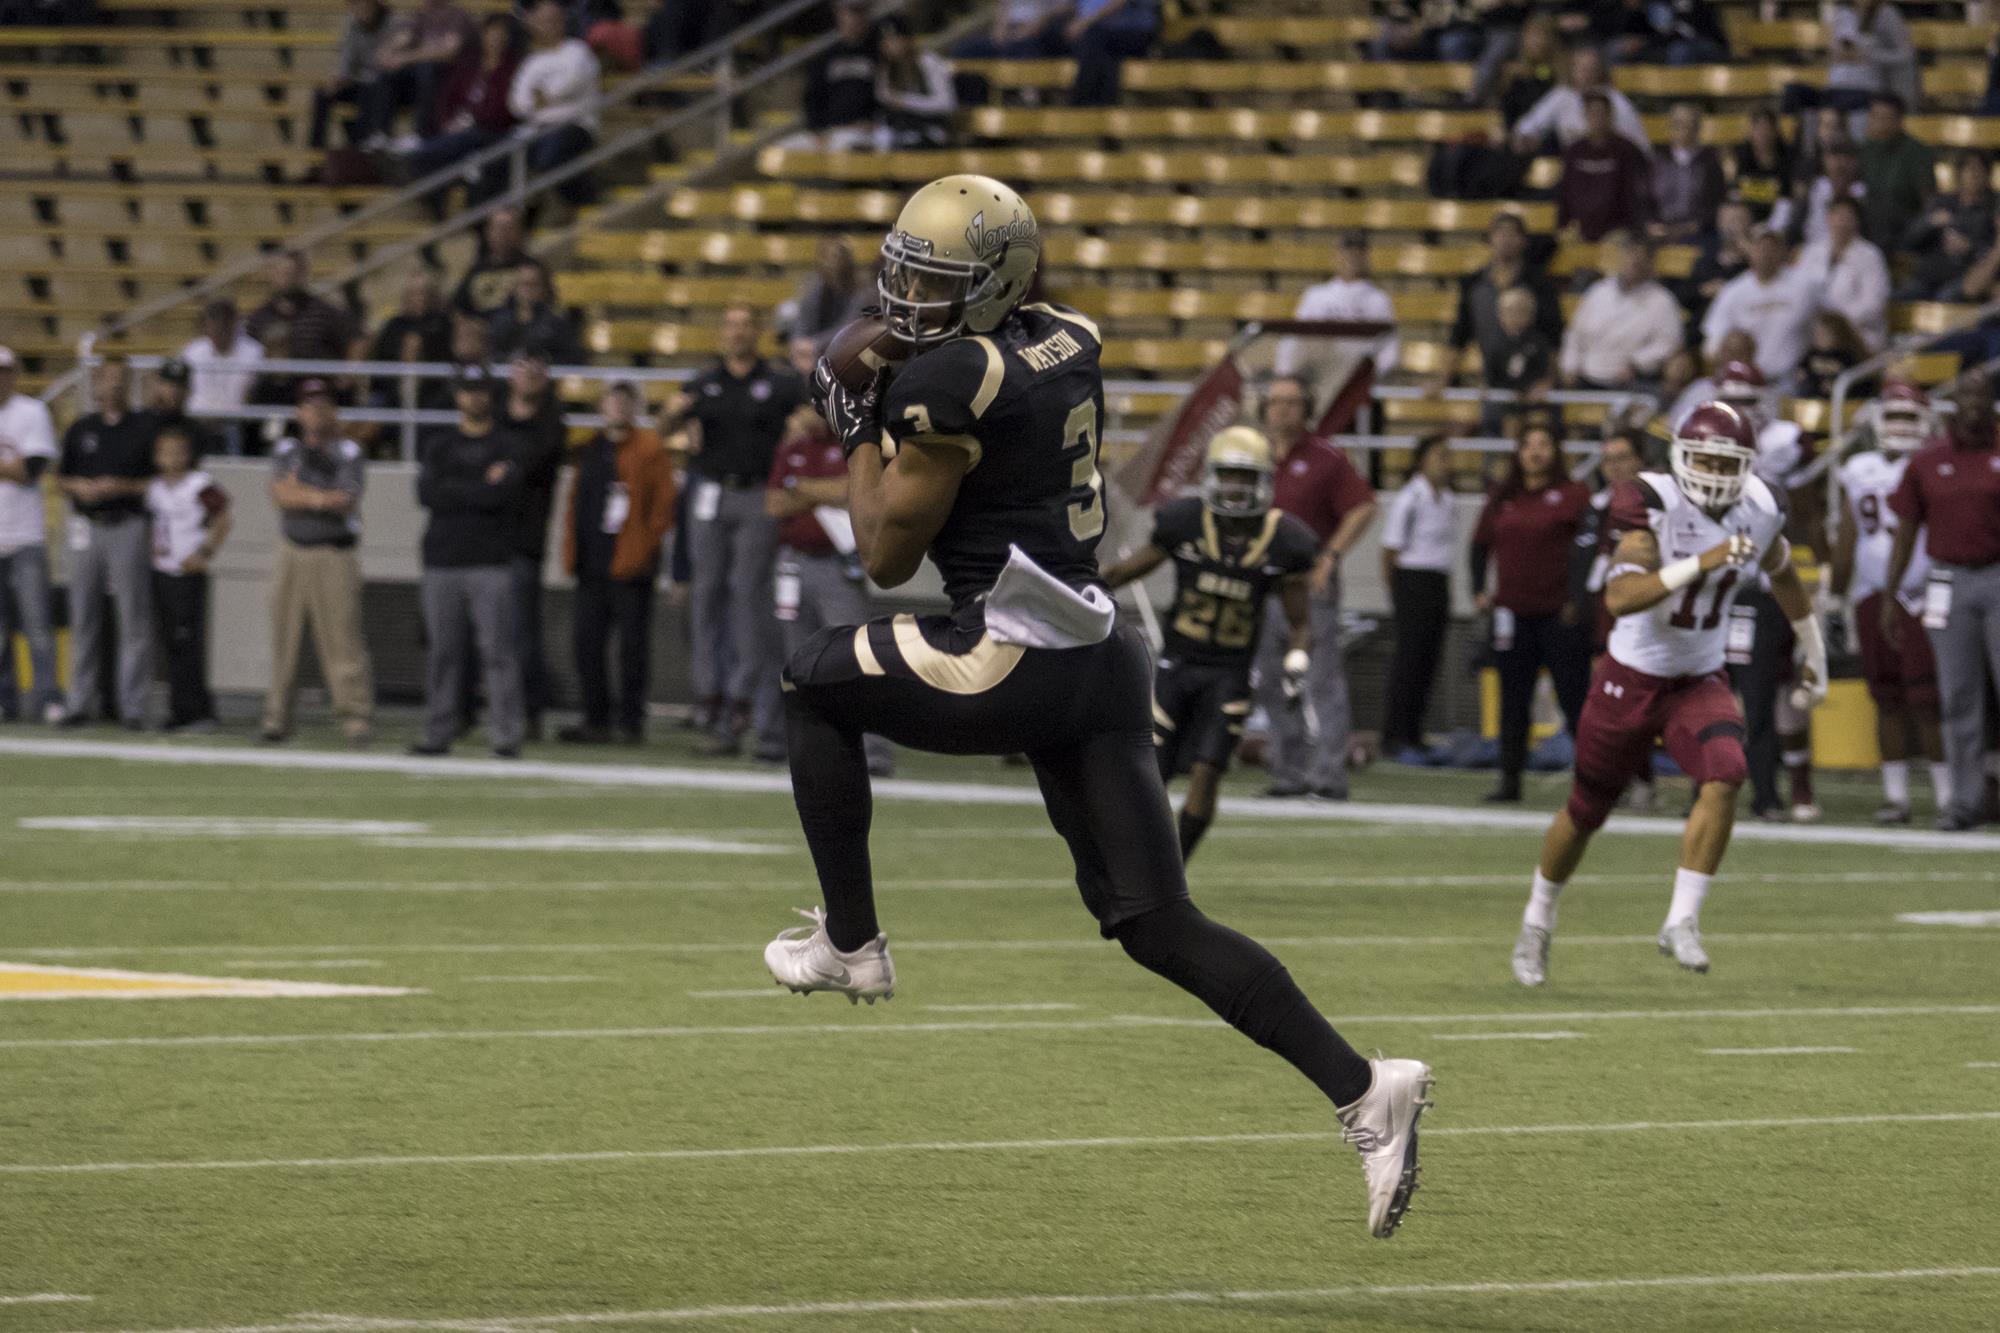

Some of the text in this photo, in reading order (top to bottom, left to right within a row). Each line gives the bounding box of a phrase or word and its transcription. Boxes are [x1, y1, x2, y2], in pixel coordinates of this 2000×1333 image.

[1016, 328, 1082, 372] WATSON
[1061, 397, 1104, 542] 3
[1669, 567, 1738, 631] 11
